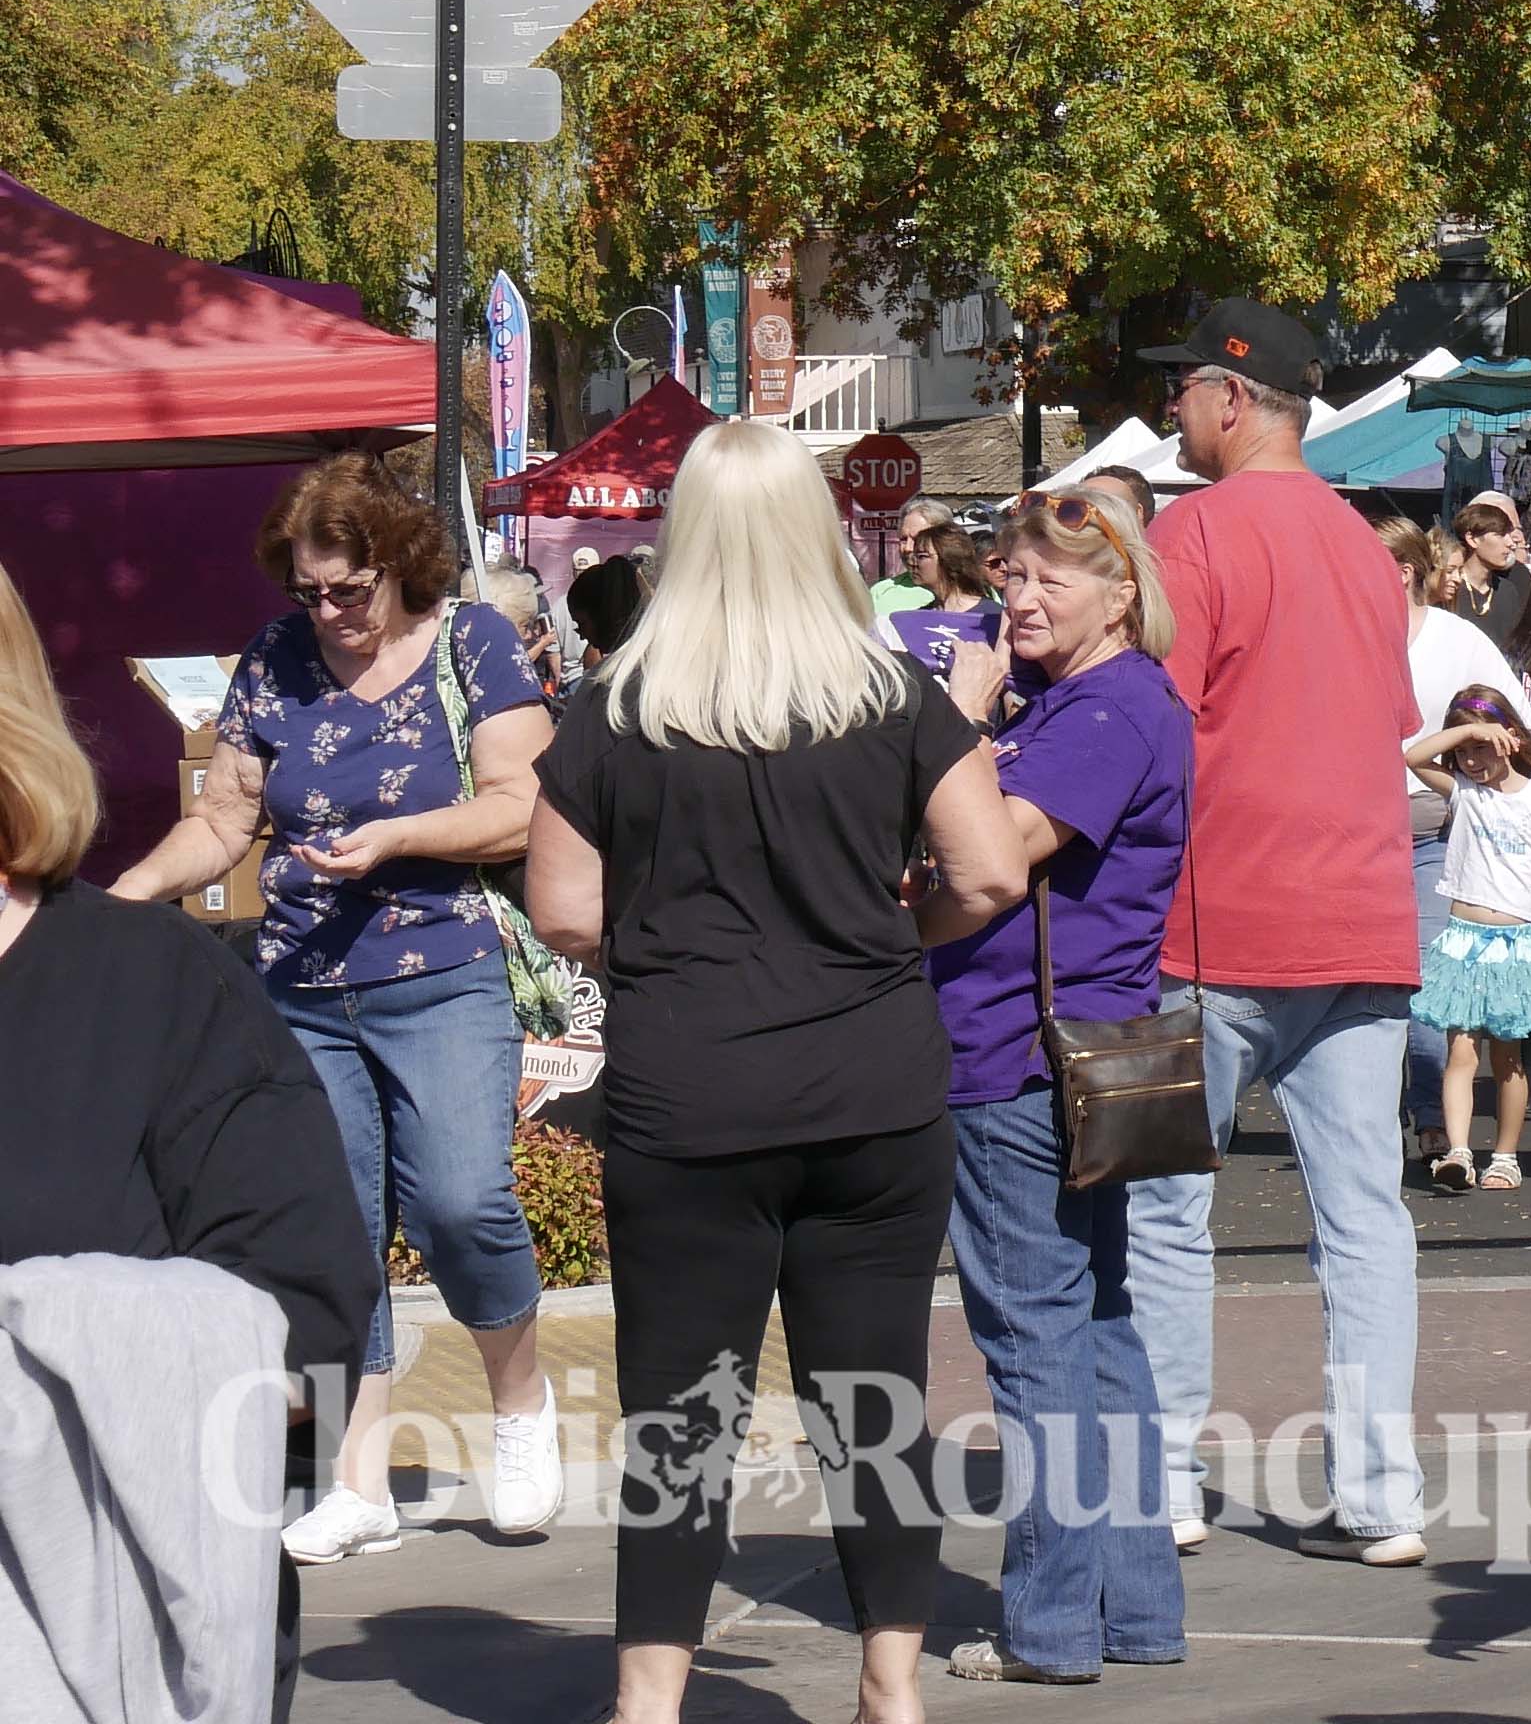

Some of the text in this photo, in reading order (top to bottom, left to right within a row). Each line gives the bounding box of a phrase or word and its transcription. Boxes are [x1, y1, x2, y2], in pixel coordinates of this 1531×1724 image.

[848, 458, 917, 489] STOP
[567, 485, 615, 508] ALL
[863, 518, 899, 530] ALL WA
[524, 1054, 579, 1078] monds
